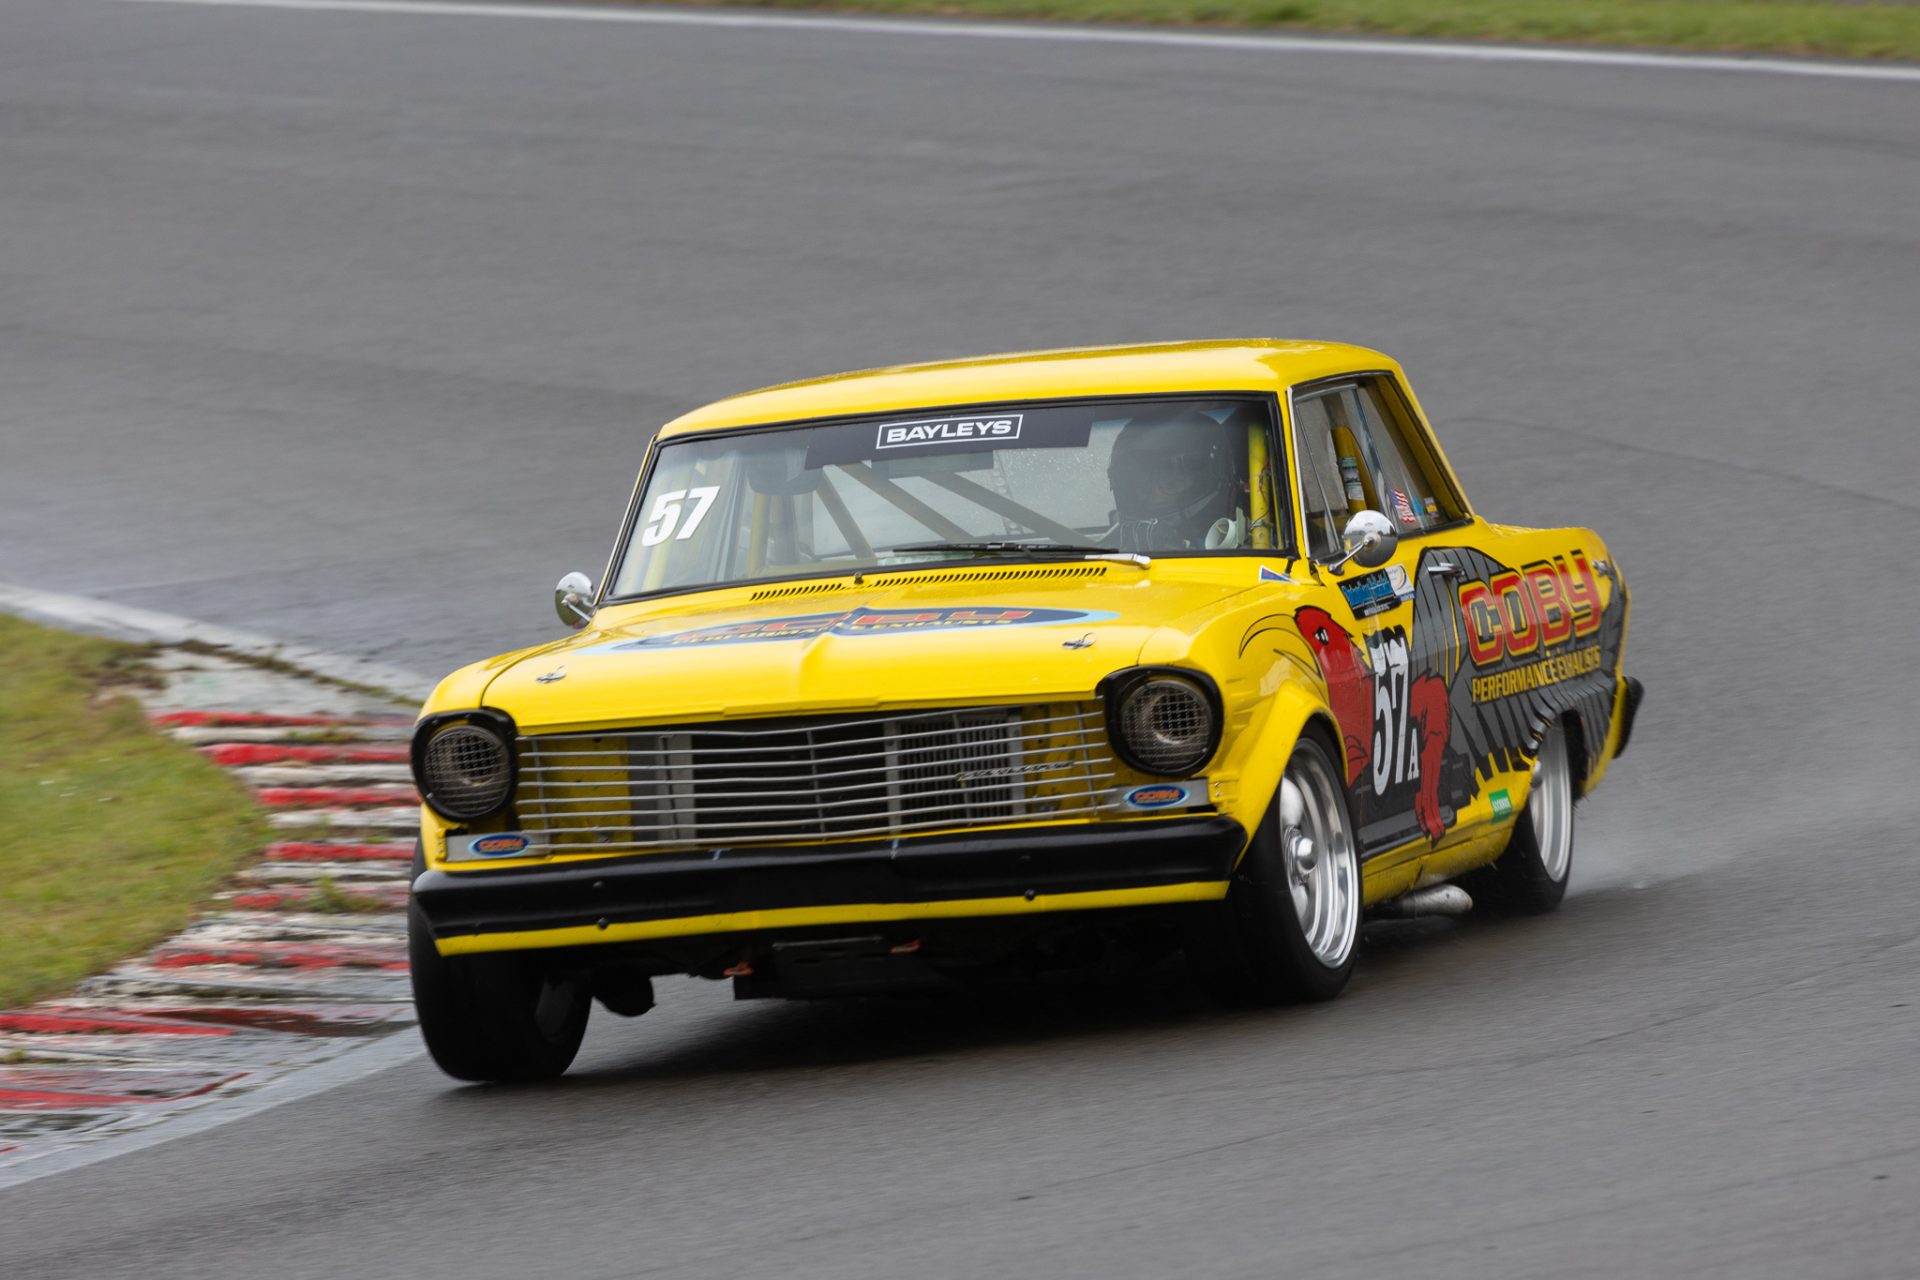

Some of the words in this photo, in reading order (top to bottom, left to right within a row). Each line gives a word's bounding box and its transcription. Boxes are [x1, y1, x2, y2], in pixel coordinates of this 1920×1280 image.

[886, 420, 1012, 444] BAYLEYS
[642, 485, 721, 547] 57
[1458, 551, 1601, 666] COBY
[1472, 658, 1559, 703] PERFORMANCE
